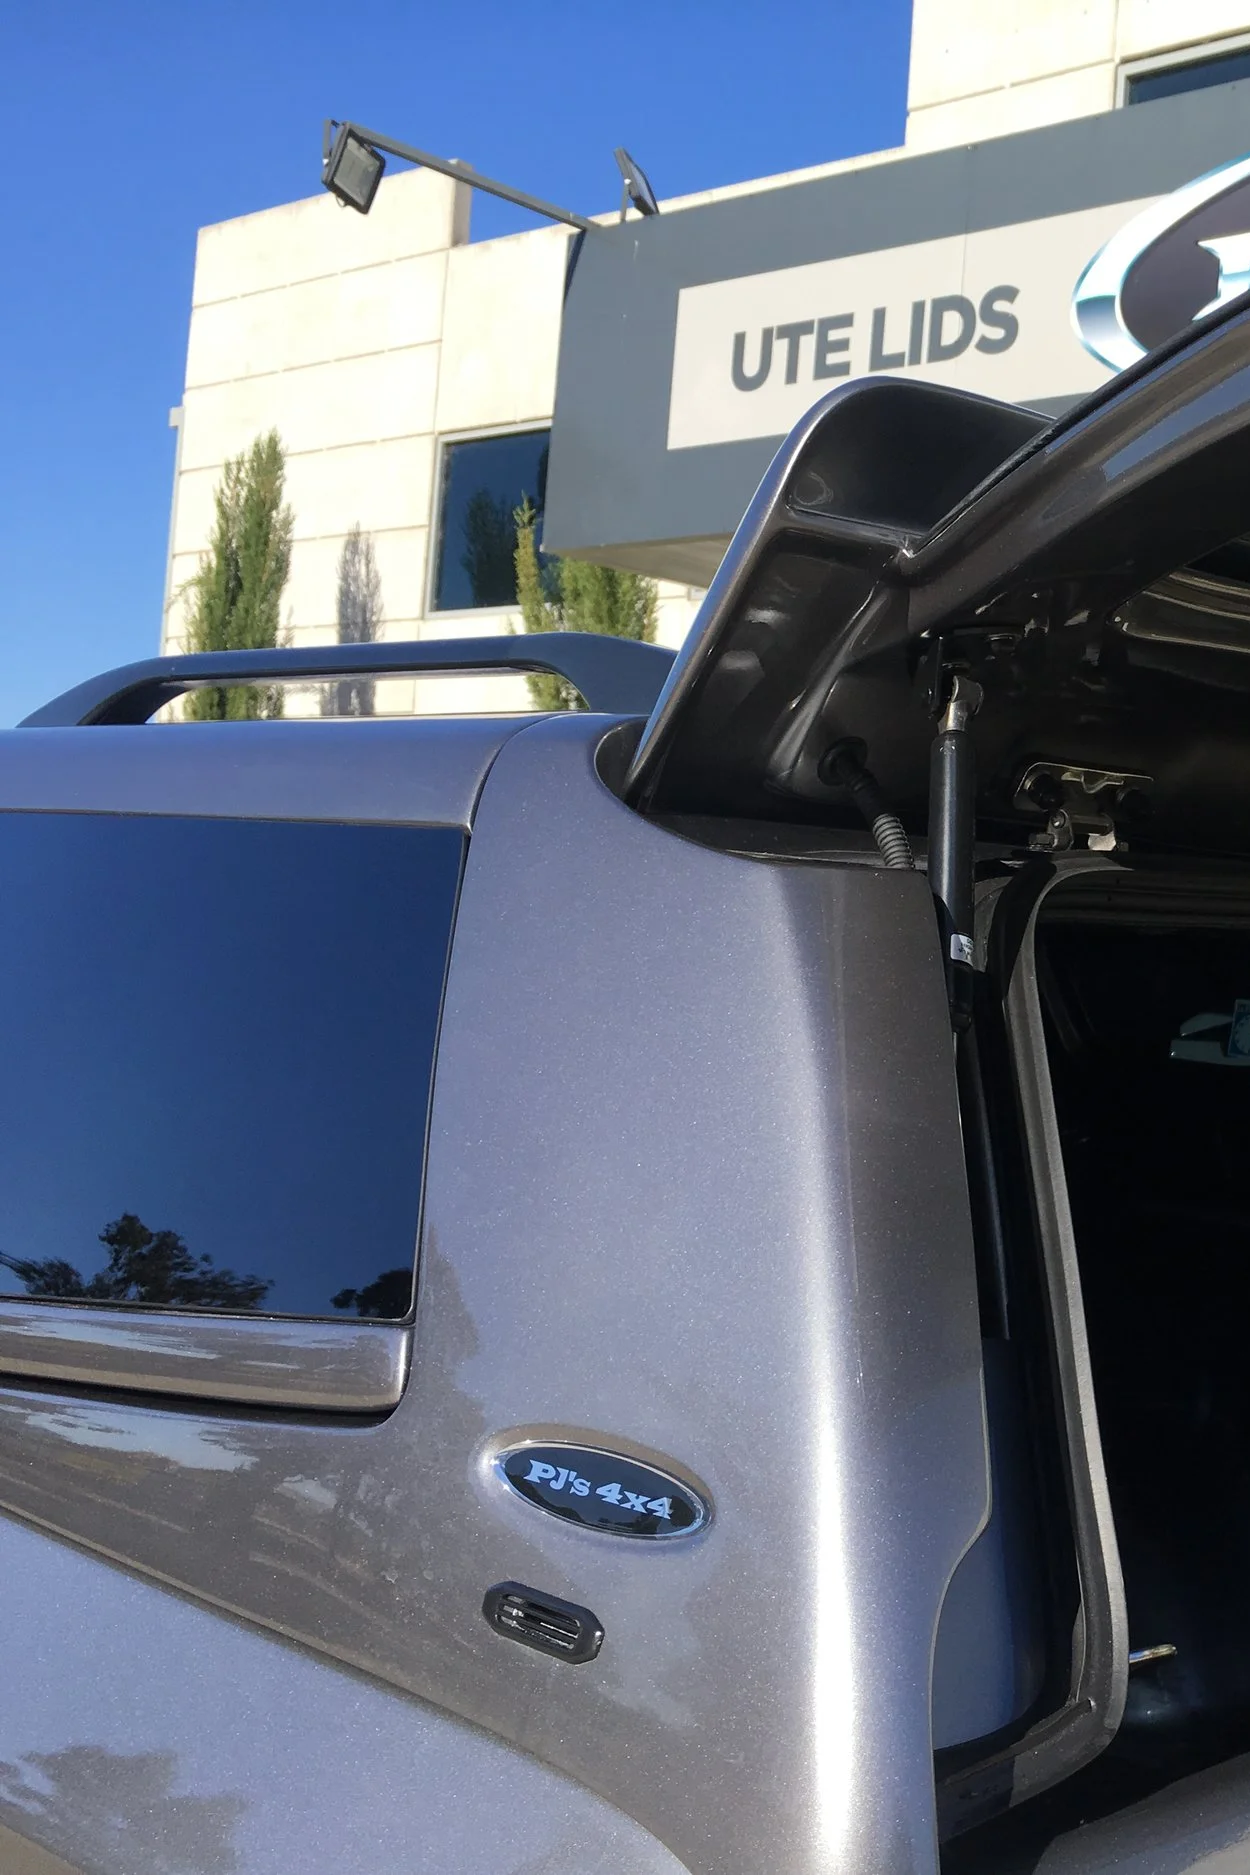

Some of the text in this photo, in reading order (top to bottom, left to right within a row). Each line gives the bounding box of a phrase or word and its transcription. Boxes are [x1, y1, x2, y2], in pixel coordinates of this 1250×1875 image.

[731, 284, 1020, 392] UTE LIDS
[523, 1459, 674, 1520] PJ's 4x4
